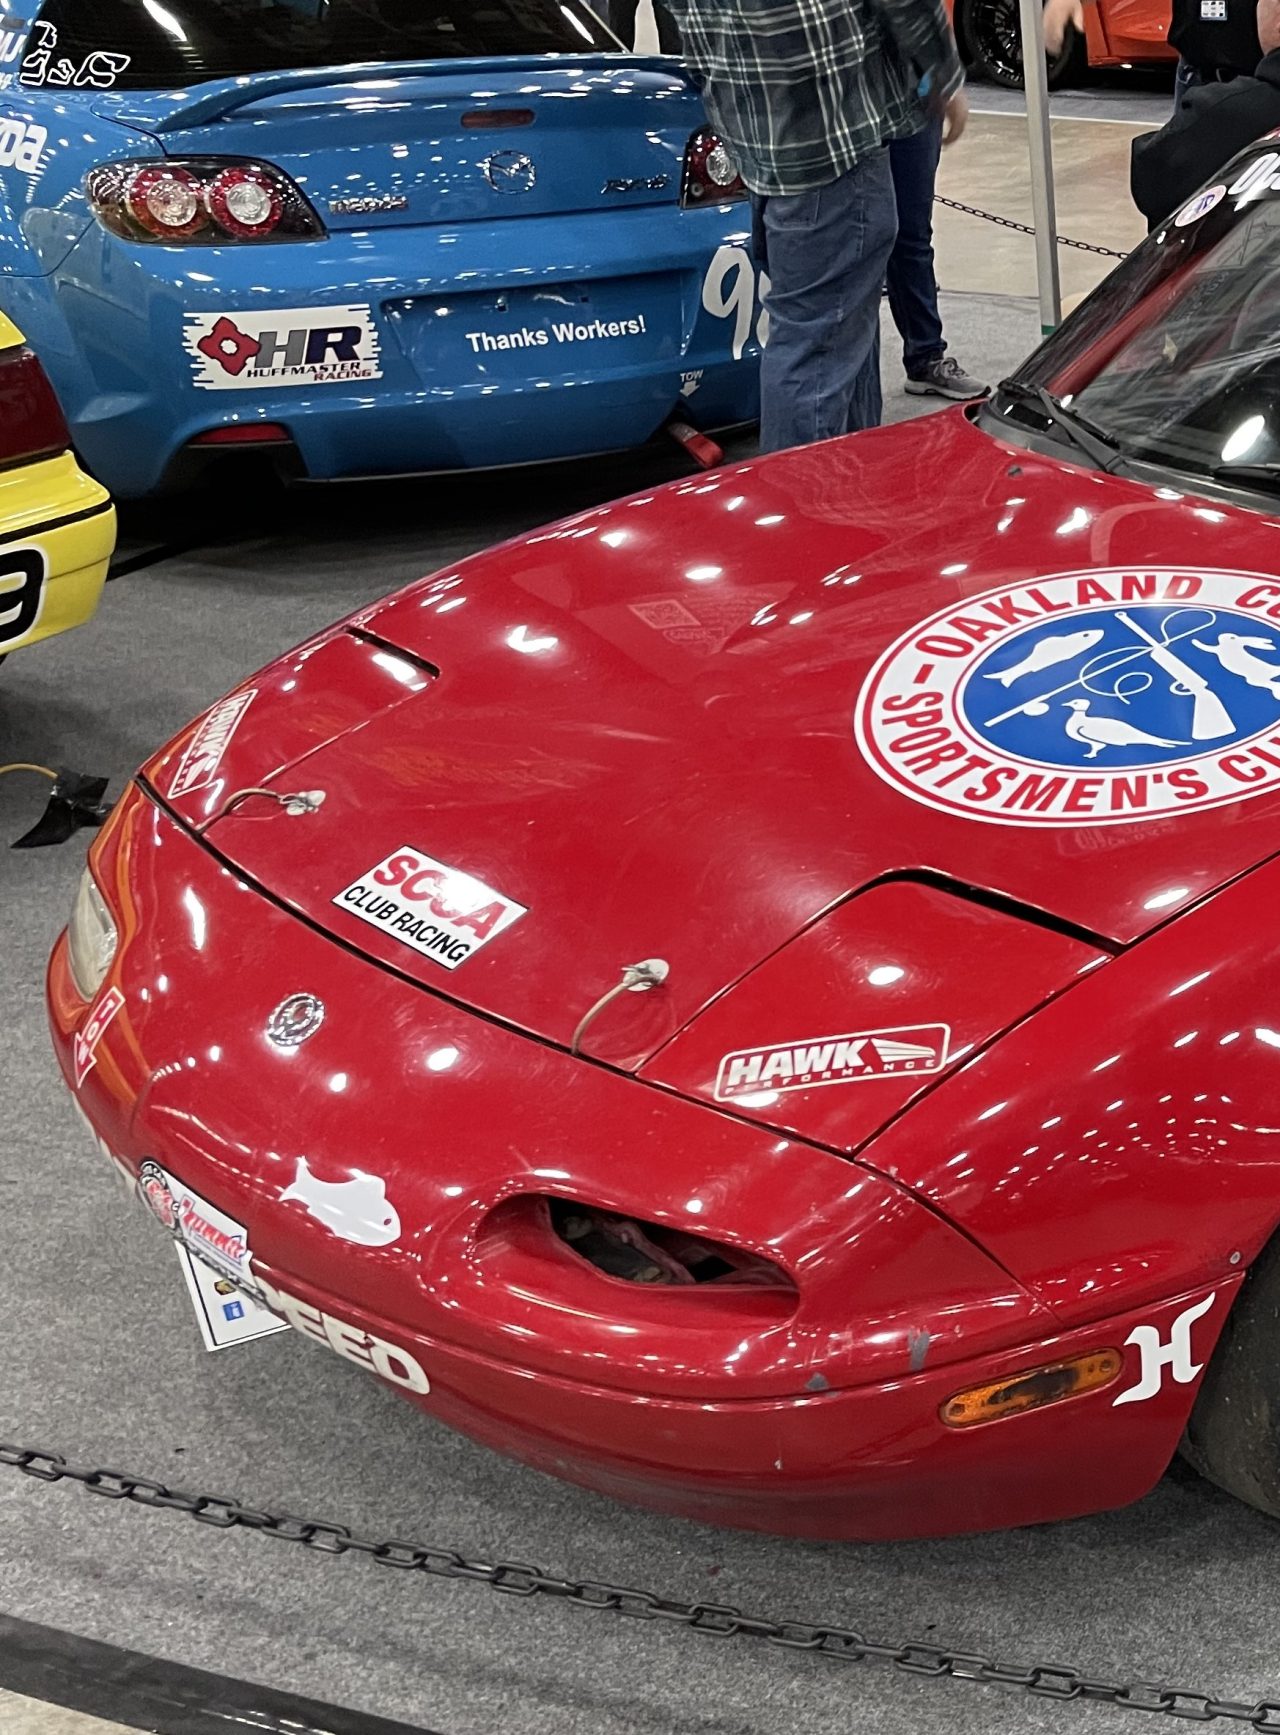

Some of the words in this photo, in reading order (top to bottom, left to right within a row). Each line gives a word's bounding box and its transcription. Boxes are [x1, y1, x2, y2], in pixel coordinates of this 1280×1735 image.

[254, 326, 362, 369] HR
[466, 327, 549, 352] Thanks
[552, 314, 647, 344] Workers!
[247, 362, 360, 378] HUFFMASTER
[314, 369, 372, 382] RACING
[680, 369, 704, 383] TOW
[914, 575, 1204, 660] OAKLAND
[881, 691, 1211, 813] SPORTSMEN'S
[343, 885, 399, 920] CLUB
[391, 911, 471, 962] RACING
[727, 1038, 870, 1087] HAWK
